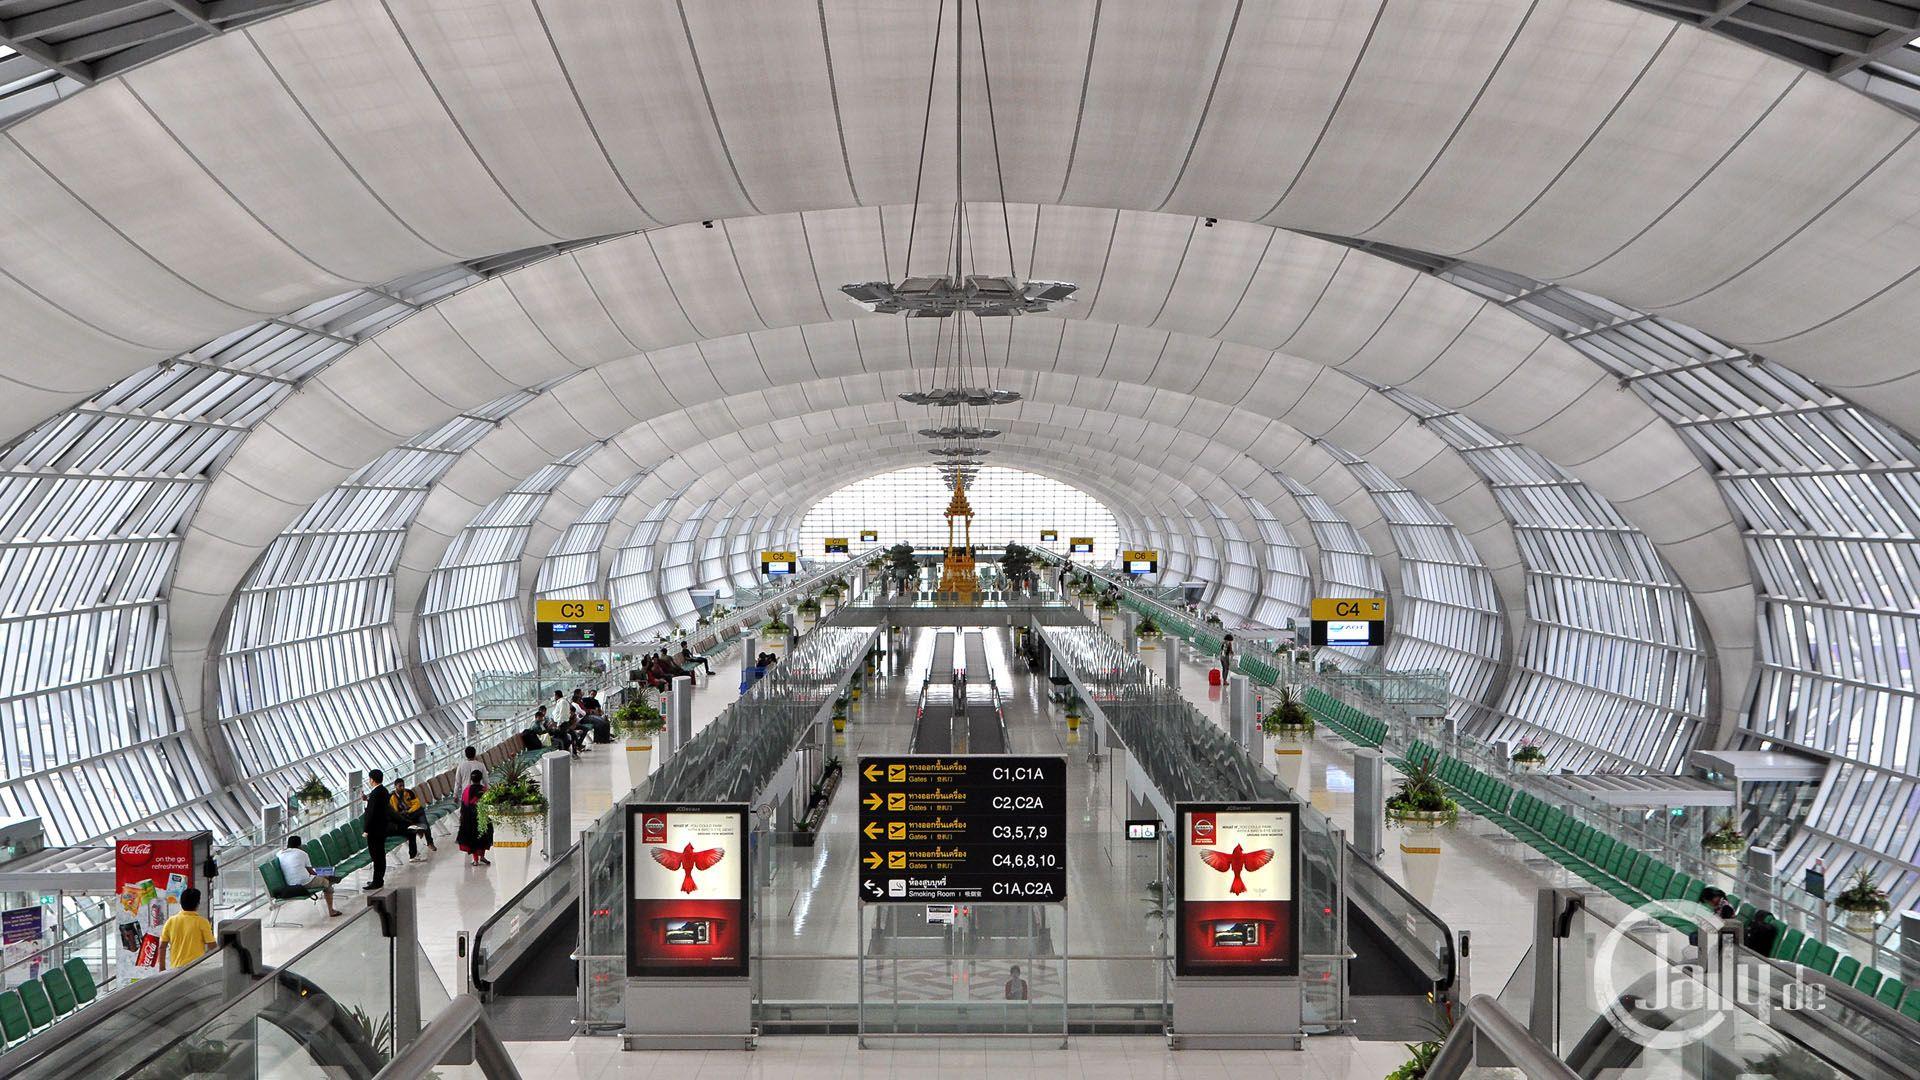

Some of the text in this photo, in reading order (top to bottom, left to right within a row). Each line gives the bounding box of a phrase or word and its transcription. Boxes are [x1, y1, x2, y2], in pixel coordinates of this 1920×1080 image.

[772, 553, 784, 561] C5
[1134, 552, 1146, 560] C6
[561, 603, 584, 618] C3
[1336, 602, 1360, 616] C4
[993, 768, 1044, 782] C1,C1A
[993, 797, 1044, 810] C2,C2A
[993, 826, 1048, 840] C3,5,7,9
[993, 855, 1056, 869] C4,6,8,10
[993, 883, 1054, 897] C1A,C2A
